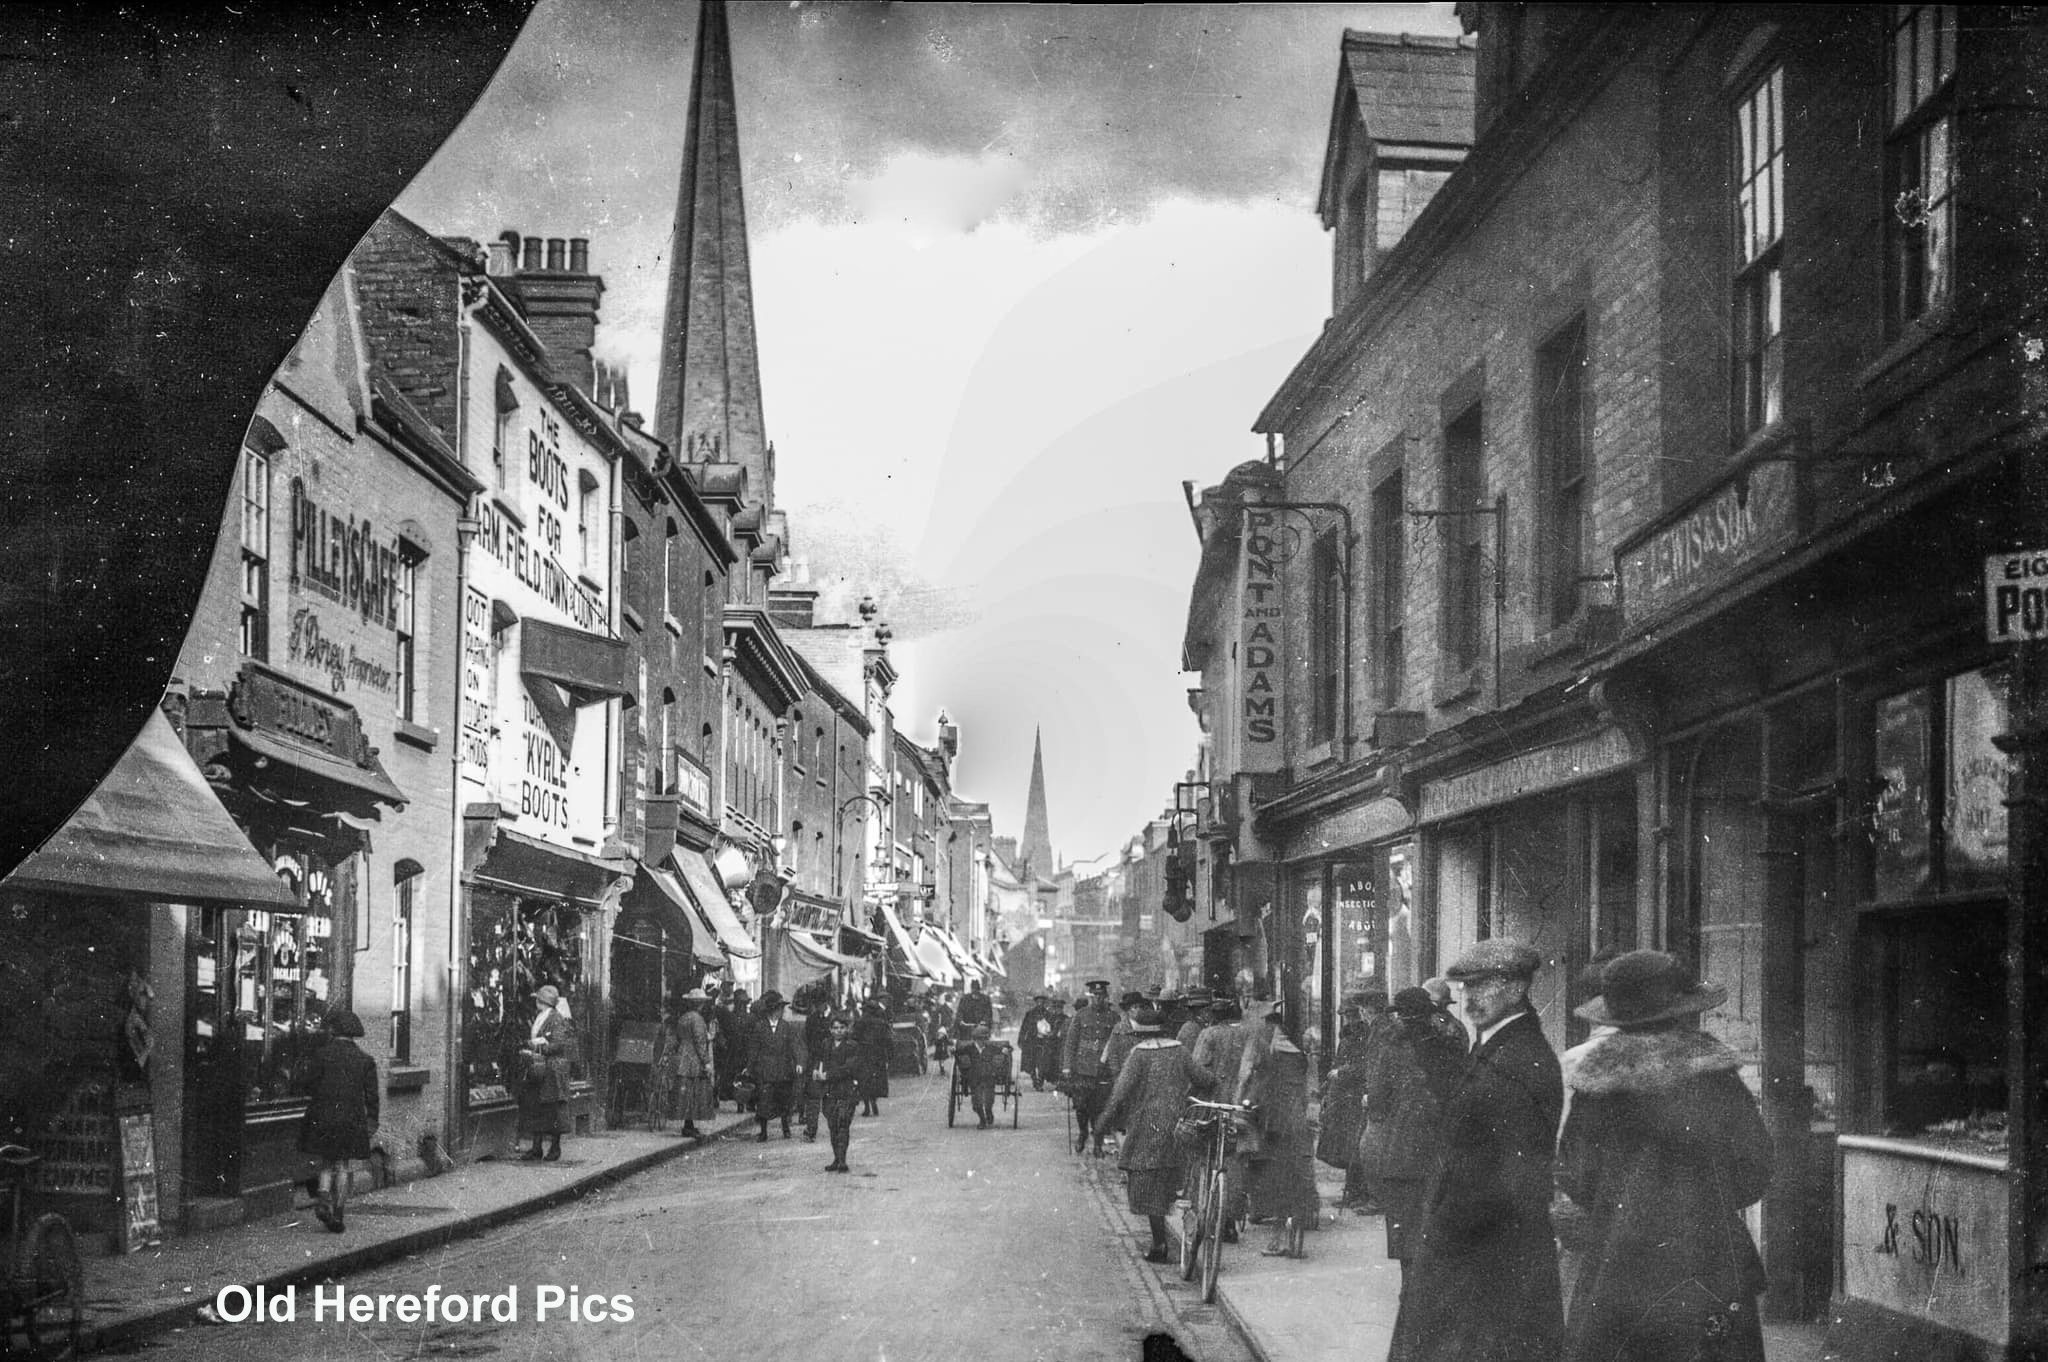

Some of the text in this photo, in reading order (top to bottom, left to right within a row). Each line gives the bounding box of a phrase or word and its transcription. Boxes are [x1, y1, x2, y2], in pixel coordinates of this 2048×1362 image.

[540, 406, 560, 450] THE
[529, 428, 568, 512] BOOTS
[538, 504, 562, 555] FOR
[1244, 607, 1280, 618] AND
[1997, 585, 2048, 636] PO
[1246, 622, 1275, 743] ADAMS
[1877, 1203, 1899, 1258] &
